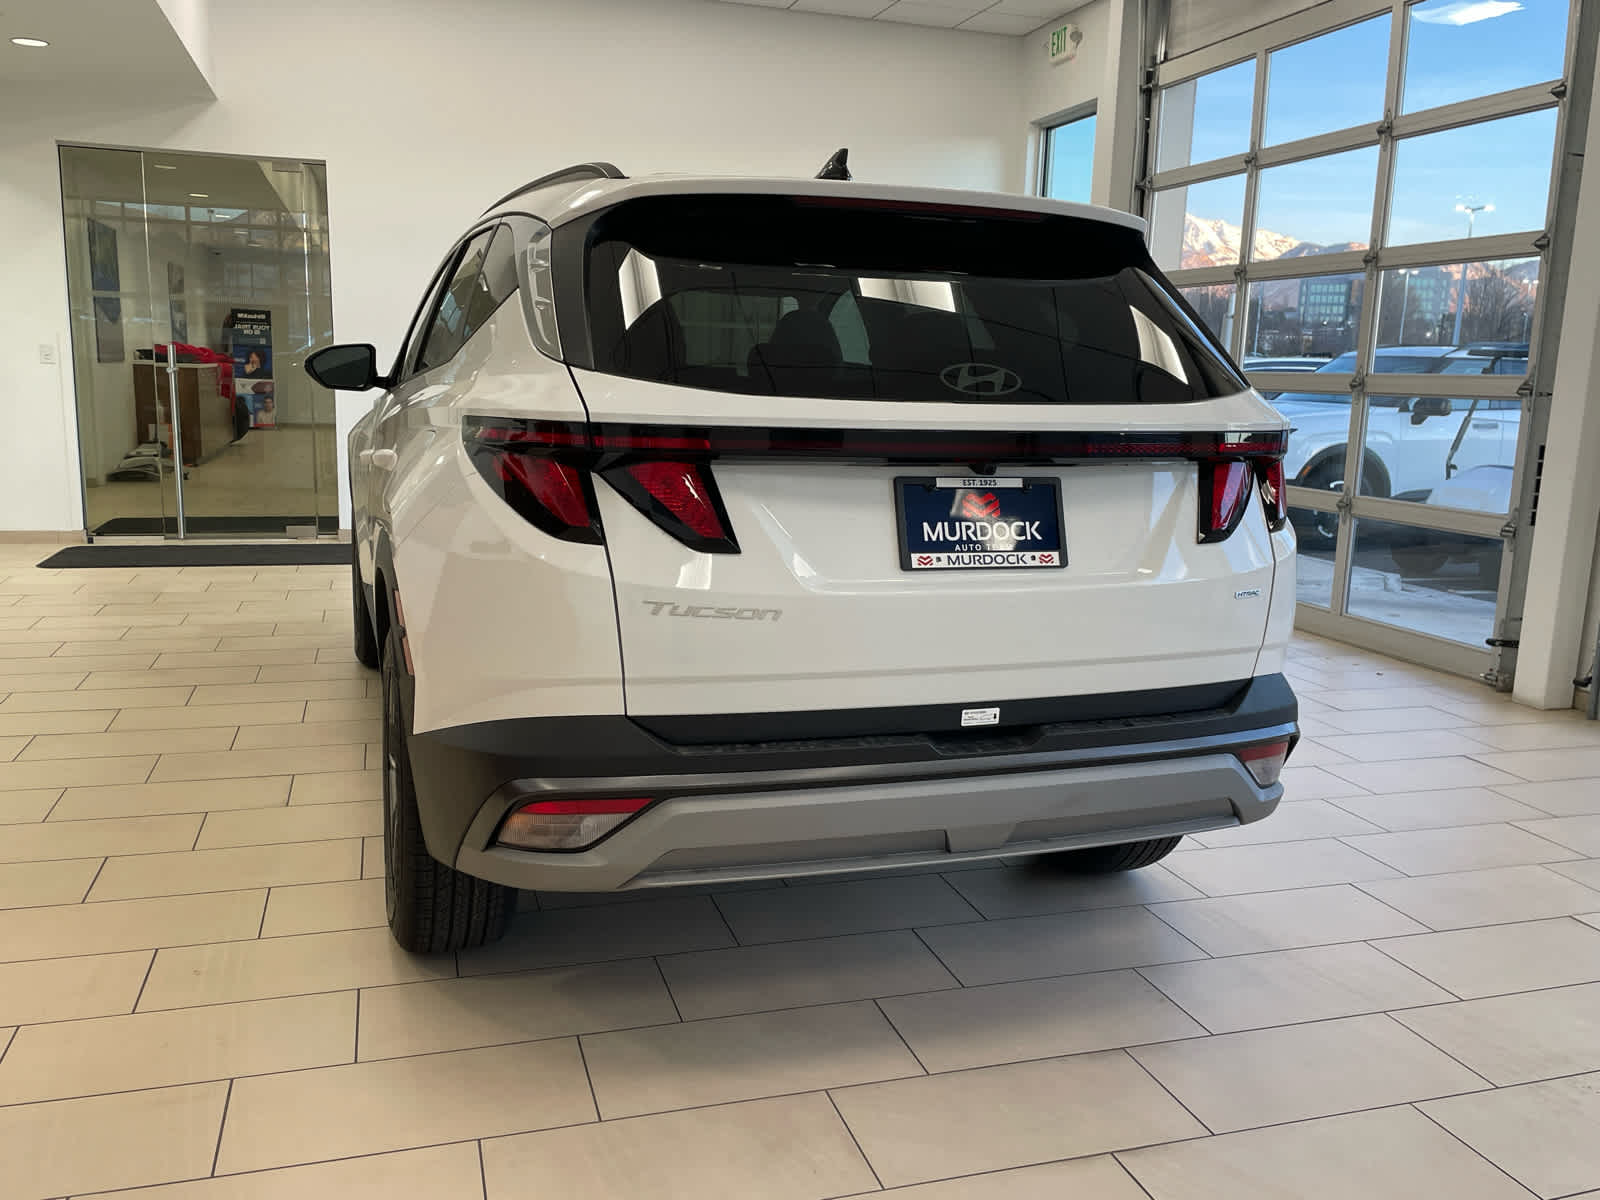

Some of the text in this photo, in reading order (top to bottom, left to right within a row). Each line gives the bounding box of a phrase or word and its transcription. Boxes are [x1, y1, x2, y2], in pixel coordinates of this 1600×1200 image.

[1051, 26, 1067, 57] EXIT
[962, 479, 998, 487] EST. 1925
[922, 520, 1042, 542] MURDOCK
[954, 543, 982, 551] AUTO
[947, 554, 1028, 566] MURDOCK
